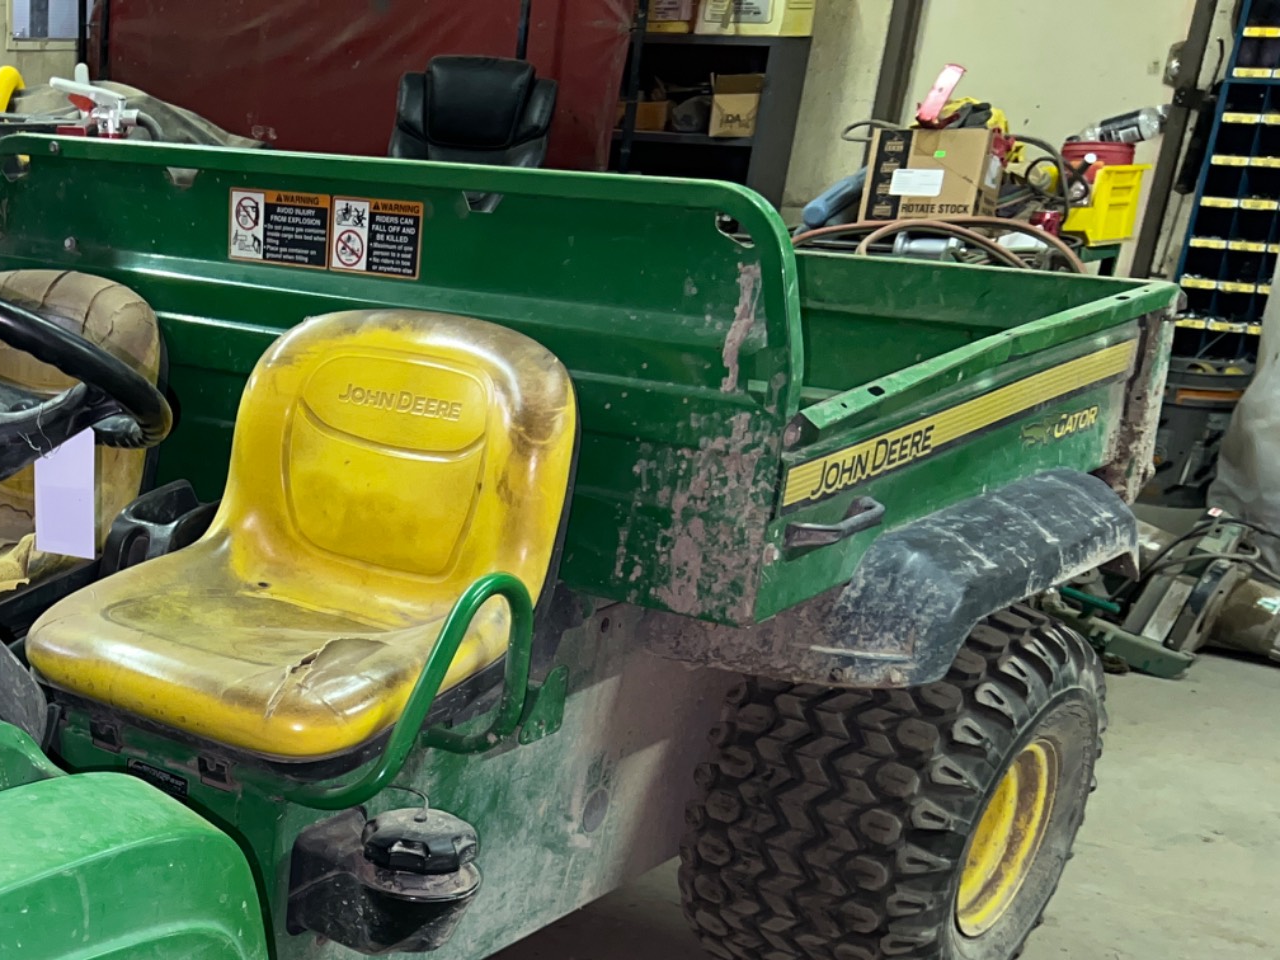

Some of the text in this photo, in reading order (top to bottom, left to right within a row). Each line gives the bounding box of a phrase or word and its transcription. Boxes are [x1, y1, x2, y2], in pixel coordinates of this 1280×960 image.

[283, 194, 320, 205] WARNING
[276, 206, 316, 217] AVOID INJURY
[381, 202, 419, 214] WARNING
[900, 203, 936, 214] ROTATE
[937, 203, 970, 215] STOCK
[269, 215, 321, 226] FROM EXPLOSION
[375, 215, 414, 225] RIDERS CAN
[371, 224, 386, 232] FALL
[402, 227, 416, 235] AND
[376, 233, 409, 243] BE KILLED
[338, 383, 463, 422] JOHN DEERE
[1054, 405, 1099, 438] GATOR
[810, 424, 936, 501] JOHN DEERE
